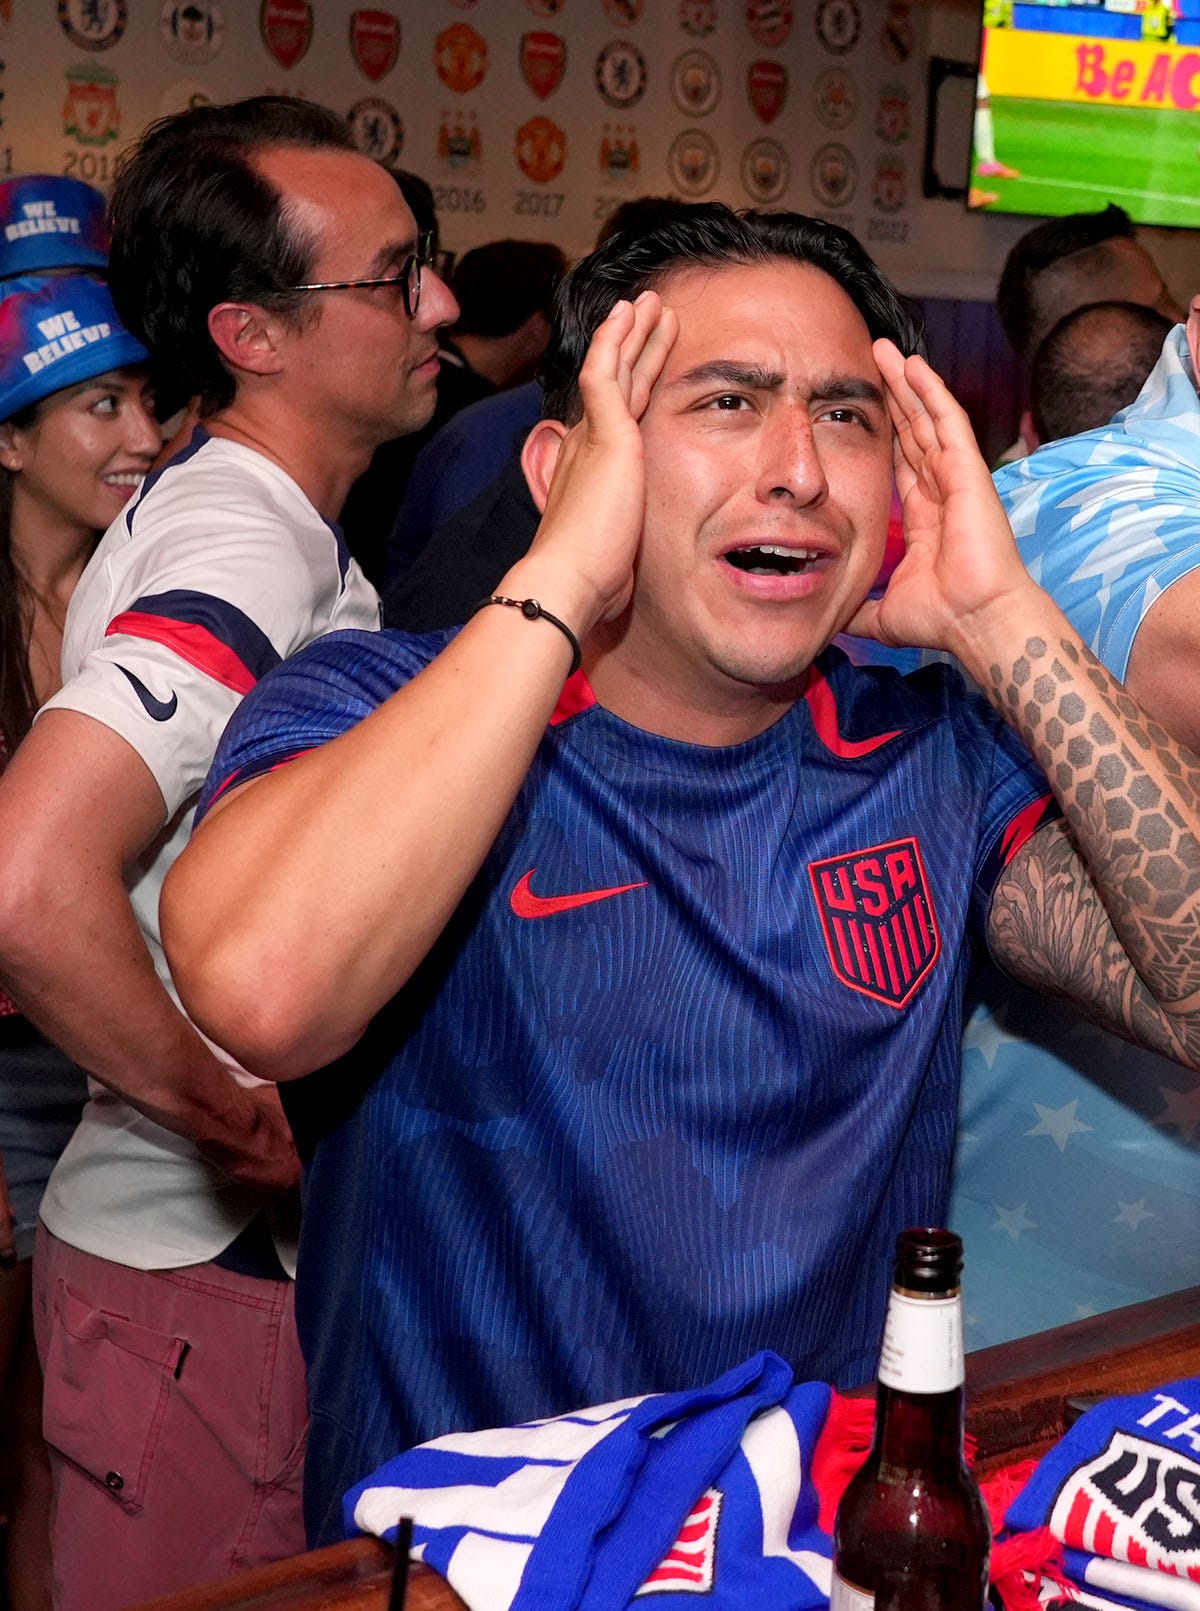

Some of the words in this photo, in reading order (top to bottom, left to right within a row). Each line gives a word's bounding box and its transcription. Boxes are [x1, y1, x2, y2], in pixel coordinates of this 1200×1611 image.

[1075, 42, 1137, 99] Be
[63, 151, 122, 181] 201
[22, 200, 57, 220] WE
[435, 187, 487, 214] 2016
[514, 191, 566, 217] 2017
[37, 310, 81, 341] WE
[22, 322, 111, 375] BELIEVE
[819, 850, 917, 917] USA
